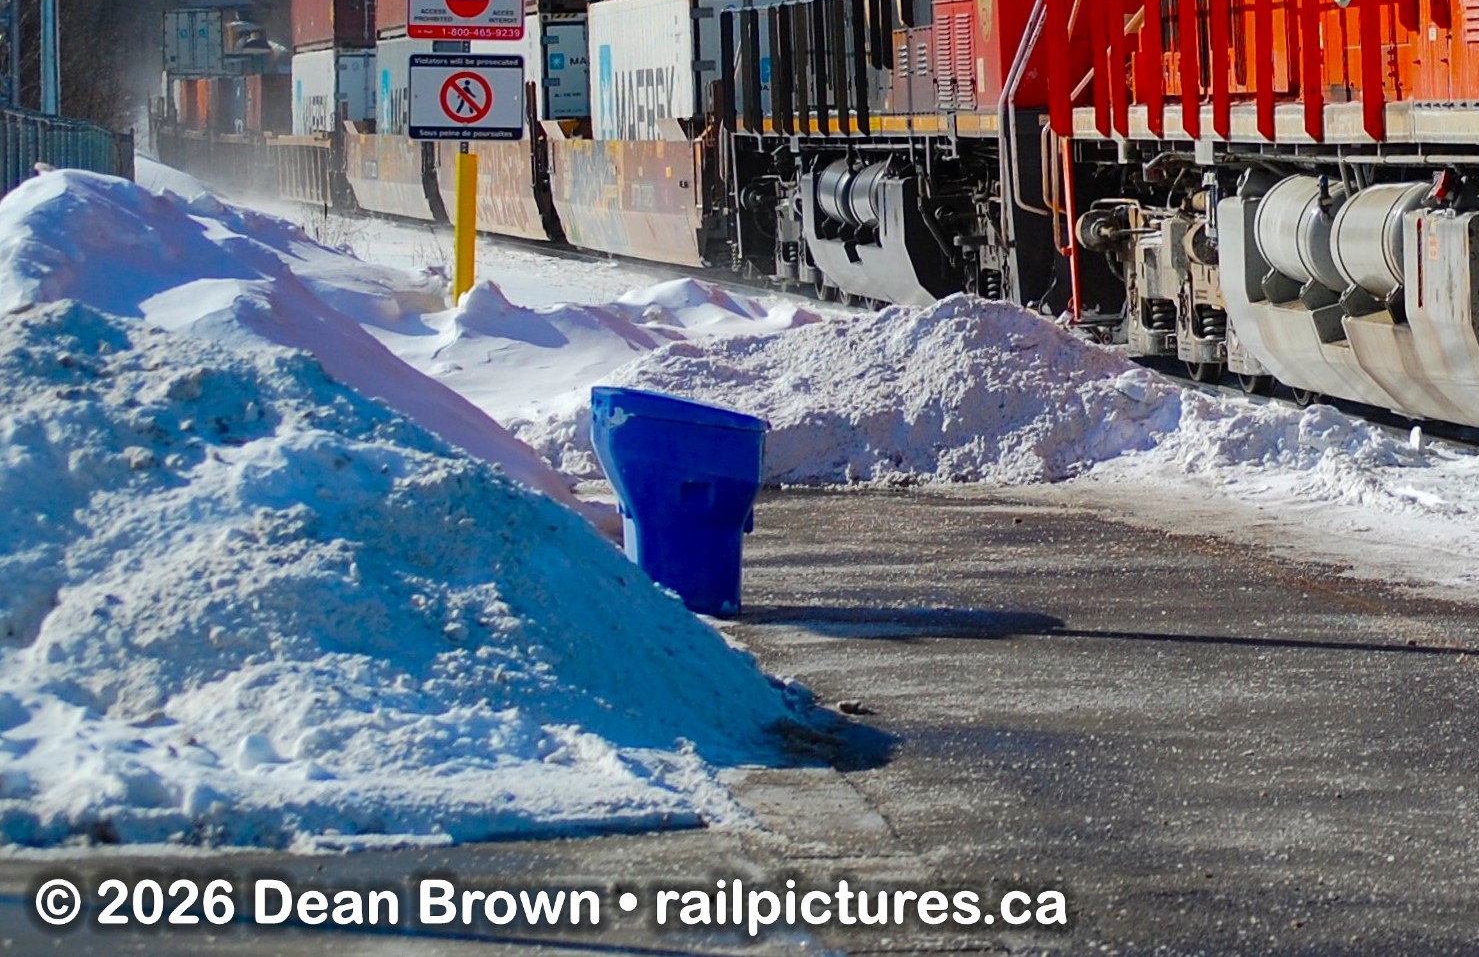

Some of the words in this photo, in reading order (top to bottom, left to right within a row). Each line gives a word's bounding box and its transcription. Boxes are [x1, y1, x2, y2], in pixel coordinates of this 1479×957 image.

[413, 15, 453, 23] PROHIBITED
[441, 27, 520, 37] 1-800-465-9239
[414, 57, 448, 65] Violators
[450, 57, 463, 65] will
[419, 129, 438, 137] Sous
[439, 129, 460, 138] peine
[461, 129, 471, 137] de
[472, 130, 513, 138] poursuites
